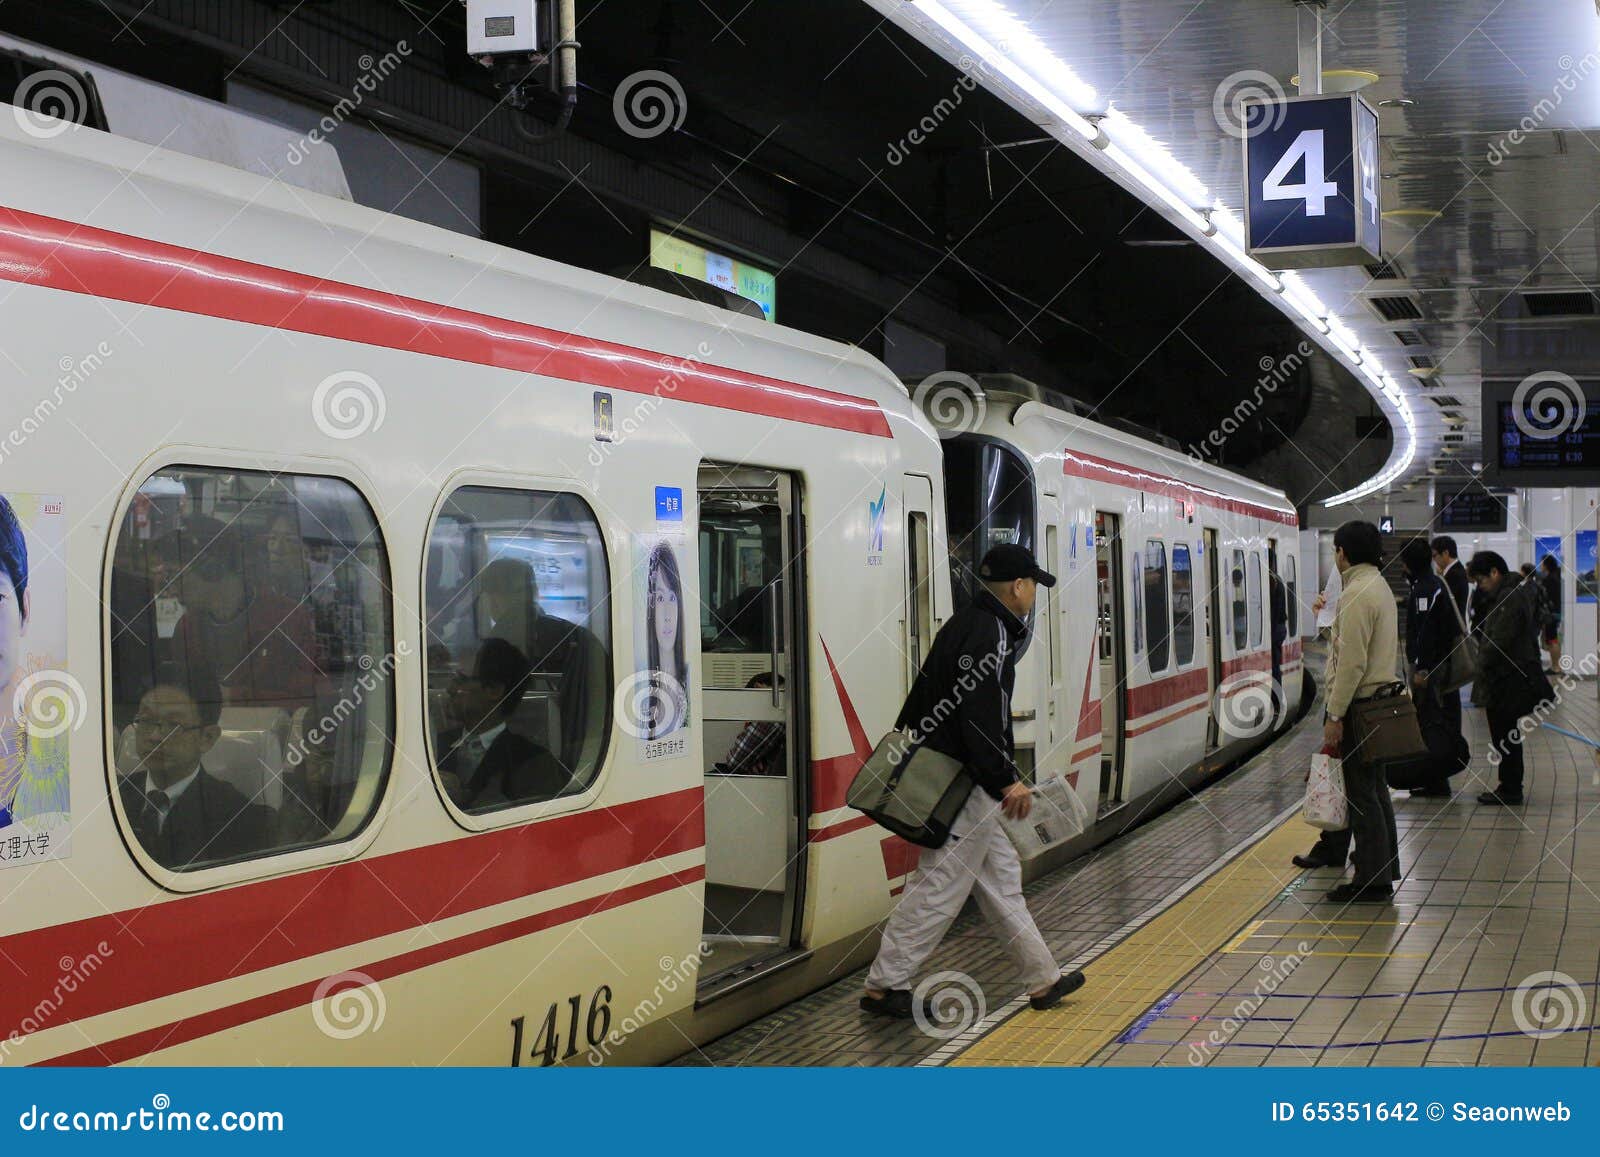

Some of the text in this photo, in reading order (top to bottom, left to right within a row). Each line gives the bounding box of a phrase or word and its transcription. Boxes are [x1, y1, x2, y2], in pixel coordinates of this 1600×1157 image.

[1262, 129, 1338, 217] 4
[1381, 520, 1393, 533] 4
[511, 984, 612, 1067] 1416
